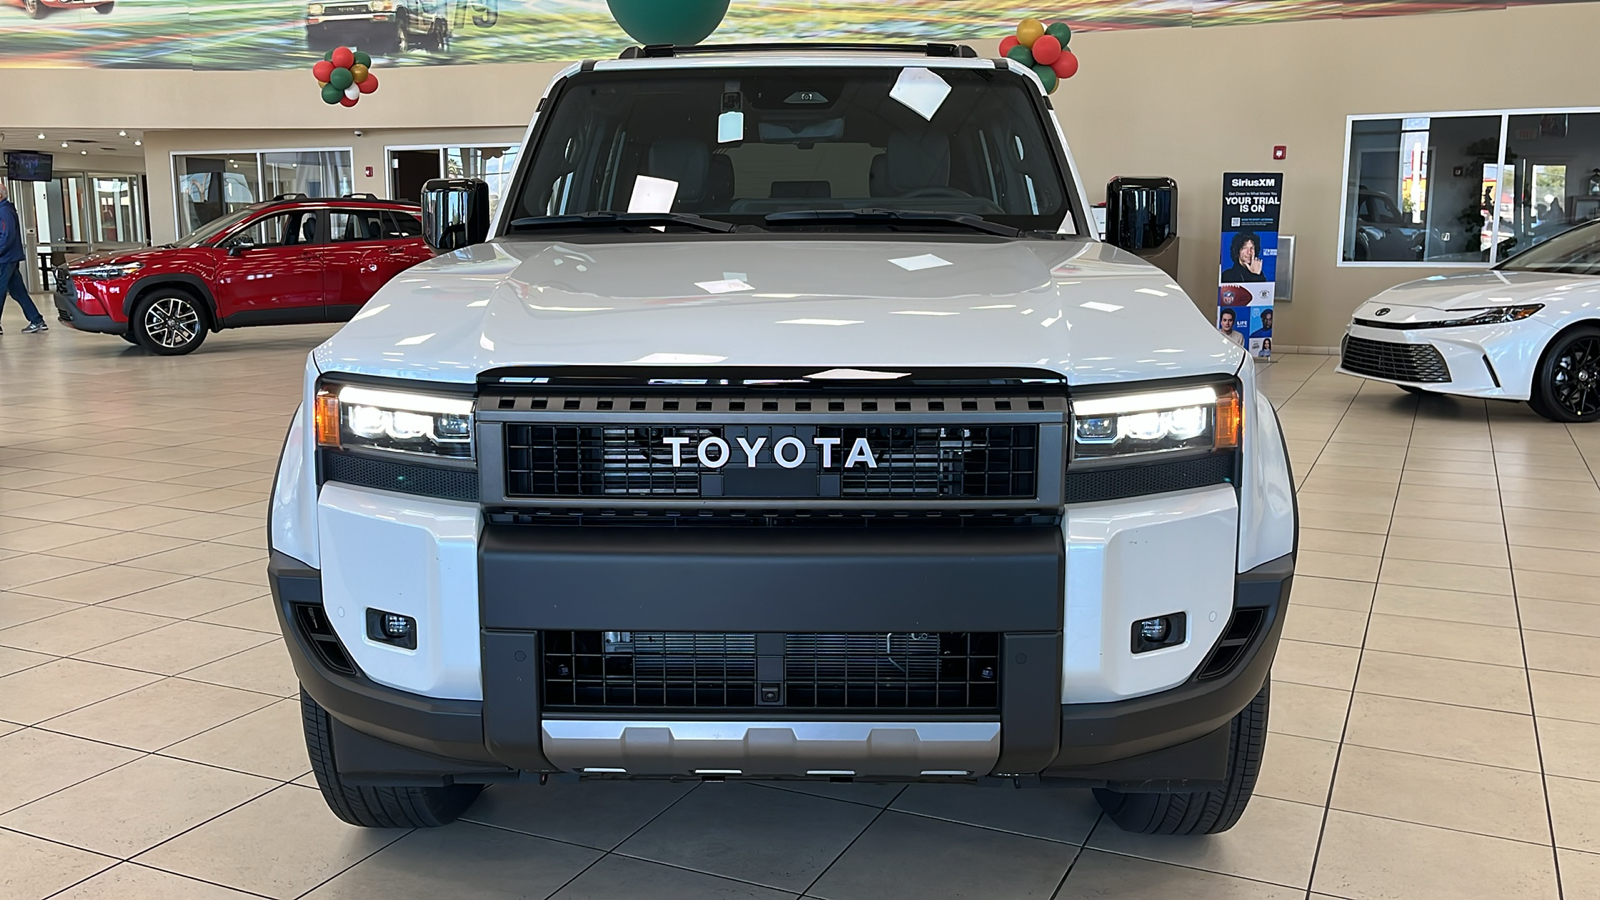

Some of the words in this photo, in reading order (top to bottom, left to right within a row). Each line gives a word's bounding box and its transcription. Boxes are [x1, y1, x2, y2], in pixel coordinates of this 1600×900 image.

[1232, 178, 1275, 186] SiriusXM
[1225, 196, 1251, 204] YOUR
[1253, 196, 1280, 204] TRIAL
[1240, 204, 1249, 212] IS
[1250, 204, 1265, 212] ON
[663, 437, 878, 469] TOYOTA
